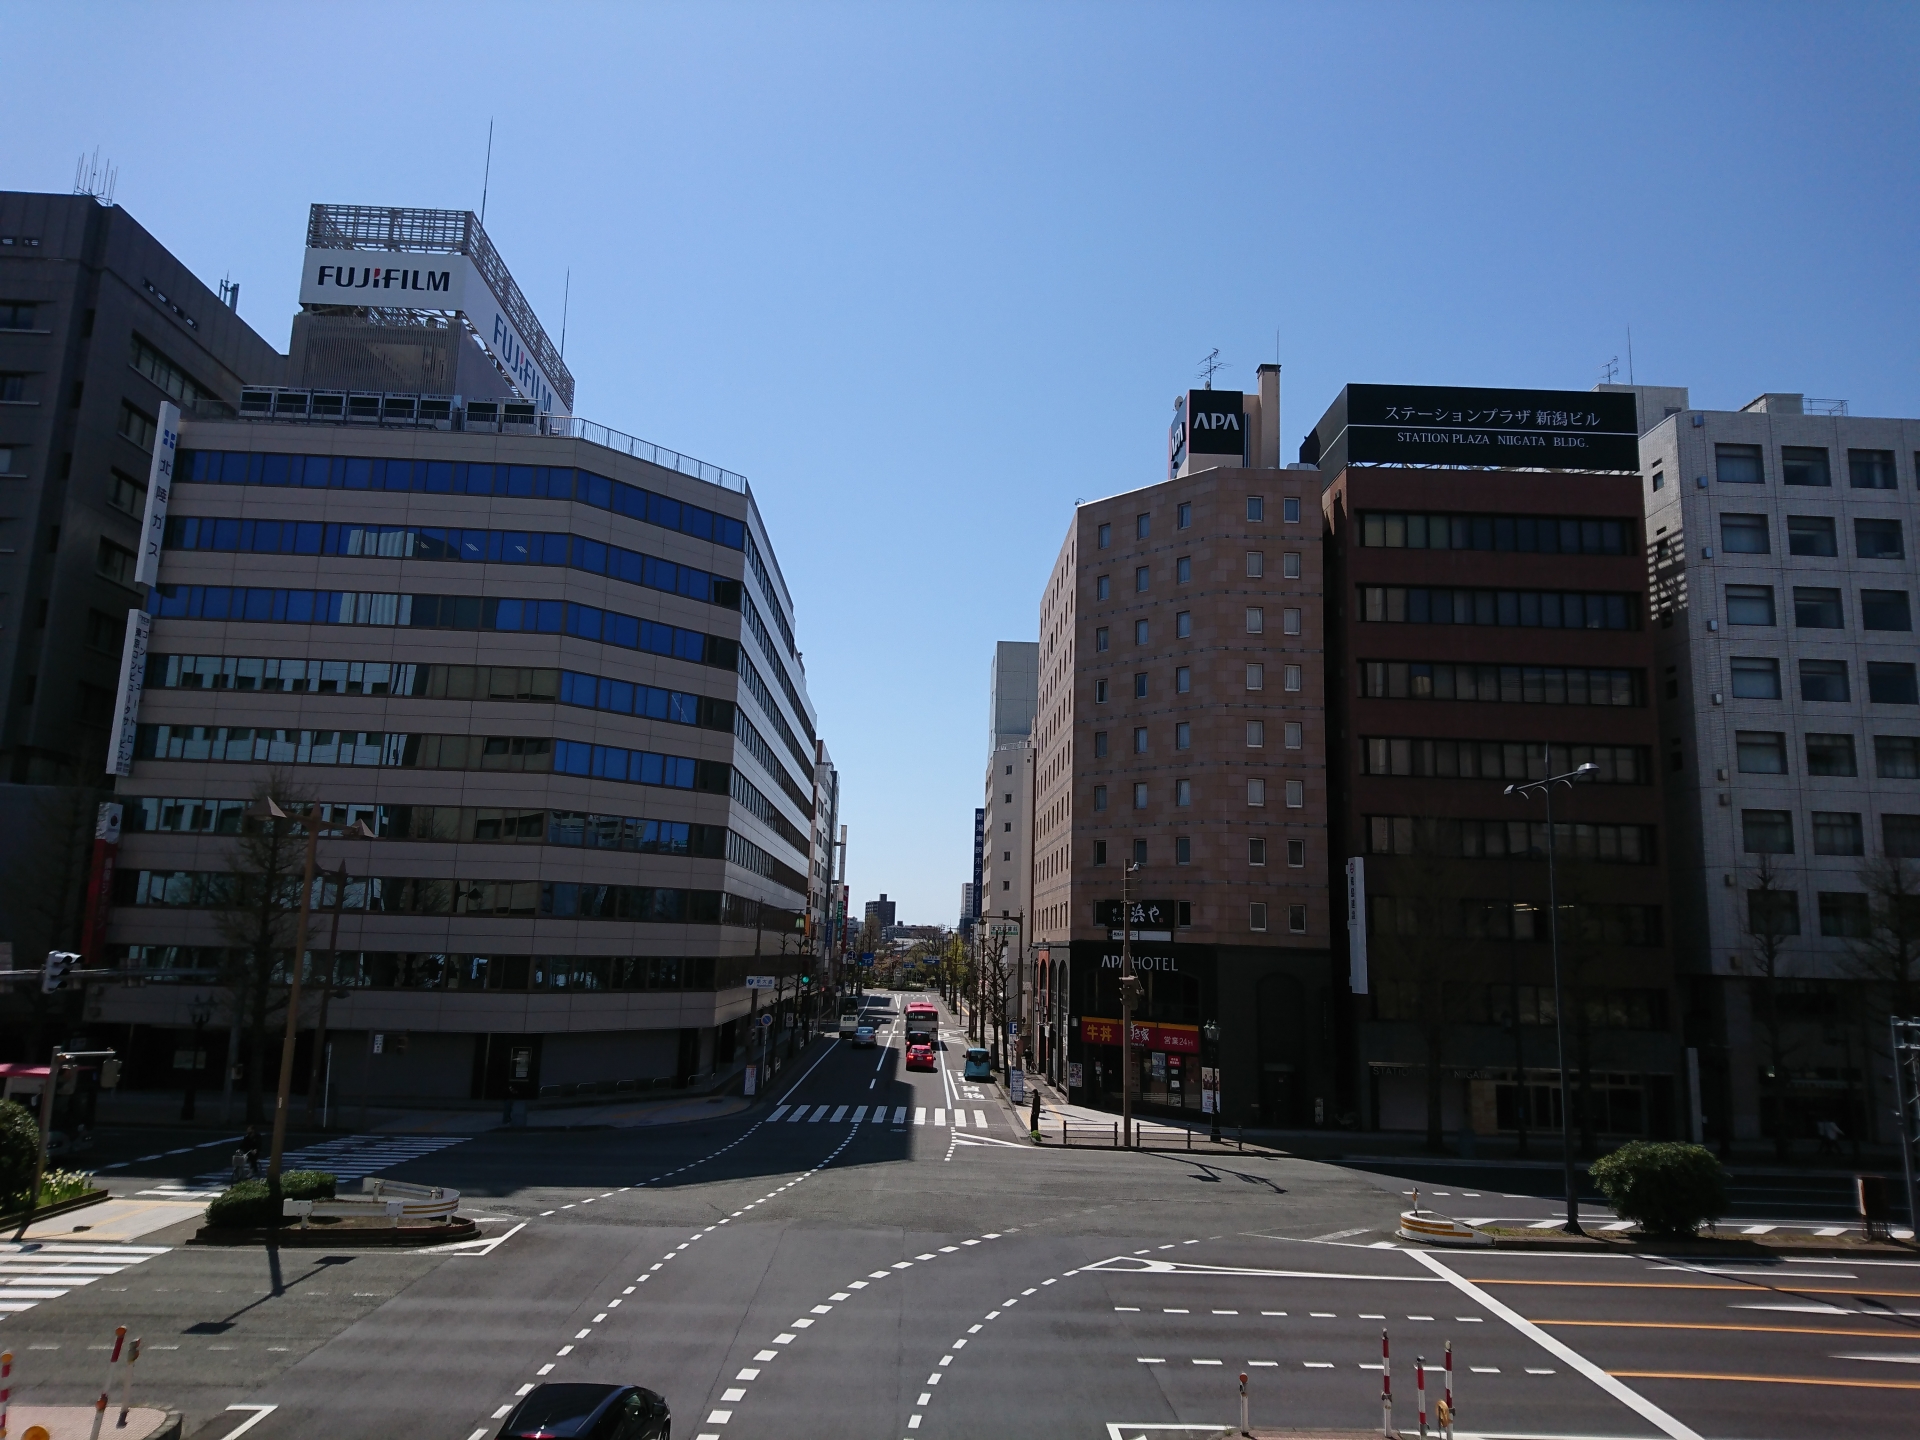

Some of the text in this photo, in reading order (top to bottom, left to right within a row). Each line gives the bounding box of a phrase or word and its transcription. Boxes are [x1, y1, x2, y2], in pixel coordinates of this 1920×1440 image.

[317, 265, 450, 292] FUJIFILM
[1193, 412, 1240, 431] APA
[1397, 431, 1589, 448] STATION PLAZA NIIGATA BLDG.
[148, 458, 172, 558] 北陸ガス
[1132, 956, 1179, 971] HOTEL
[1086, 1024, 1112, 1042] 牛丼
